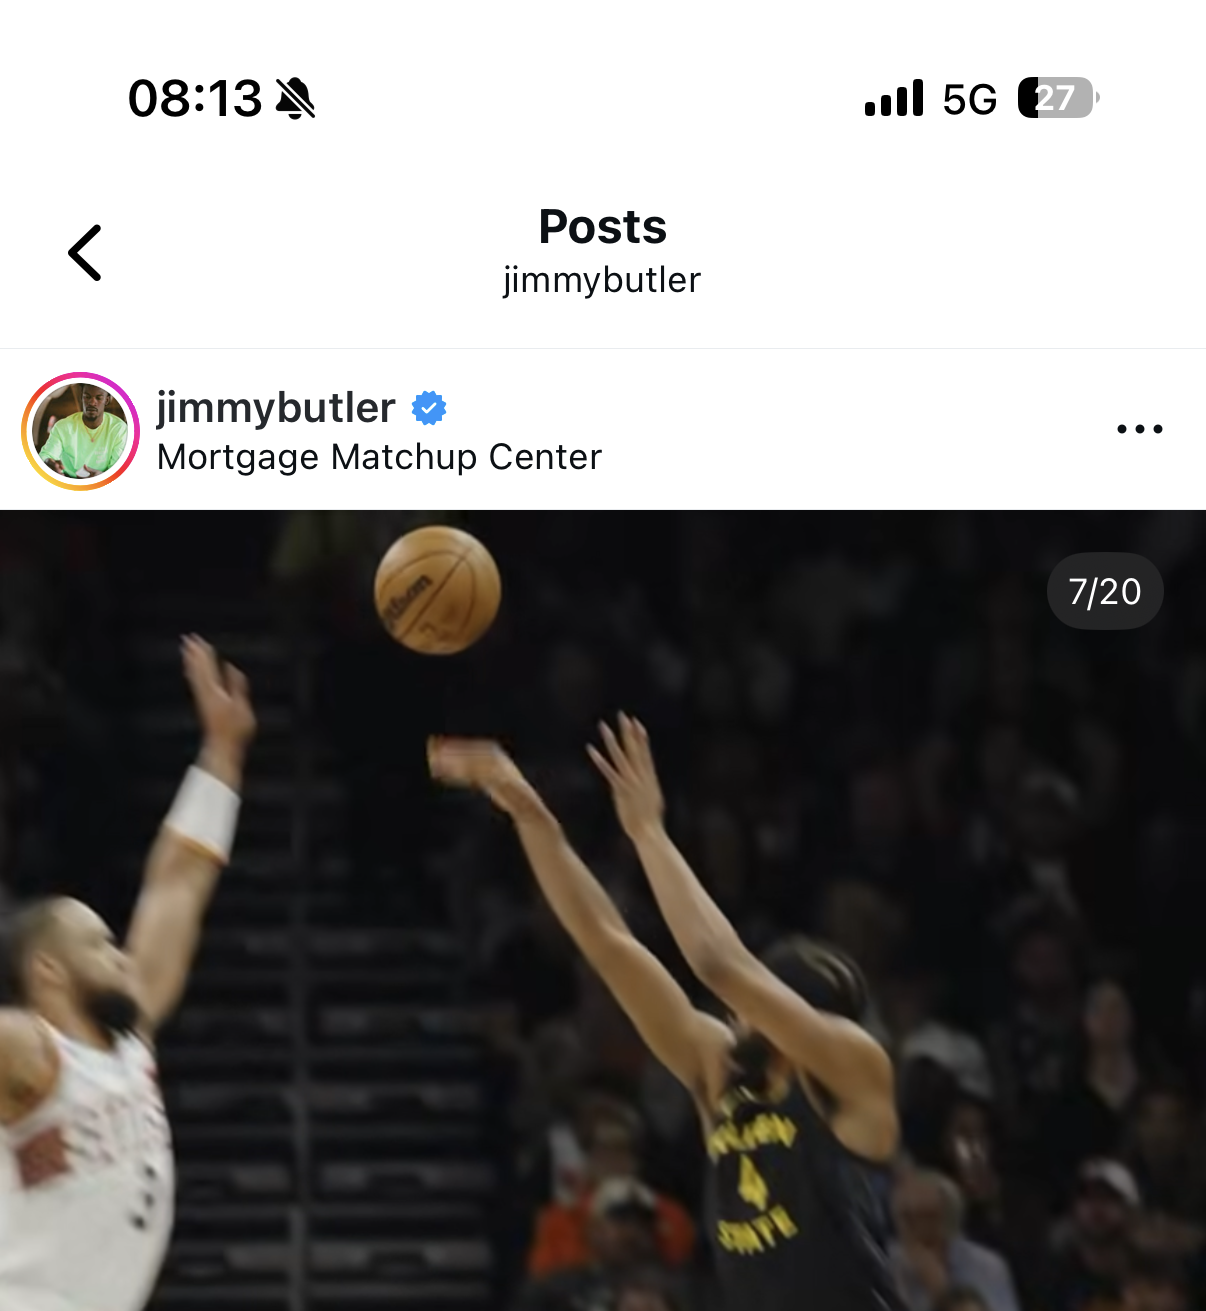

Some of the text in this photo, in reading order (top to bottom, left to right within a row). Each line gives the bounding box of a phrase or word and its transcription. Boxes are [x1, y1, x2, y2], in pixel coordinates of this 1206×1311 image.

[129, 79, 261, 117] 08:13
[943, 83, 997, 116] 5G
[1035, 84, 1075, 112] 27
[541, 209, 667, 245] Posts
[502, 265, 701, 299] jimmybutler
[156, 389, 396, 430] jimmybutler
[158, 442, 603, 476] Mortgage Matchup Center
